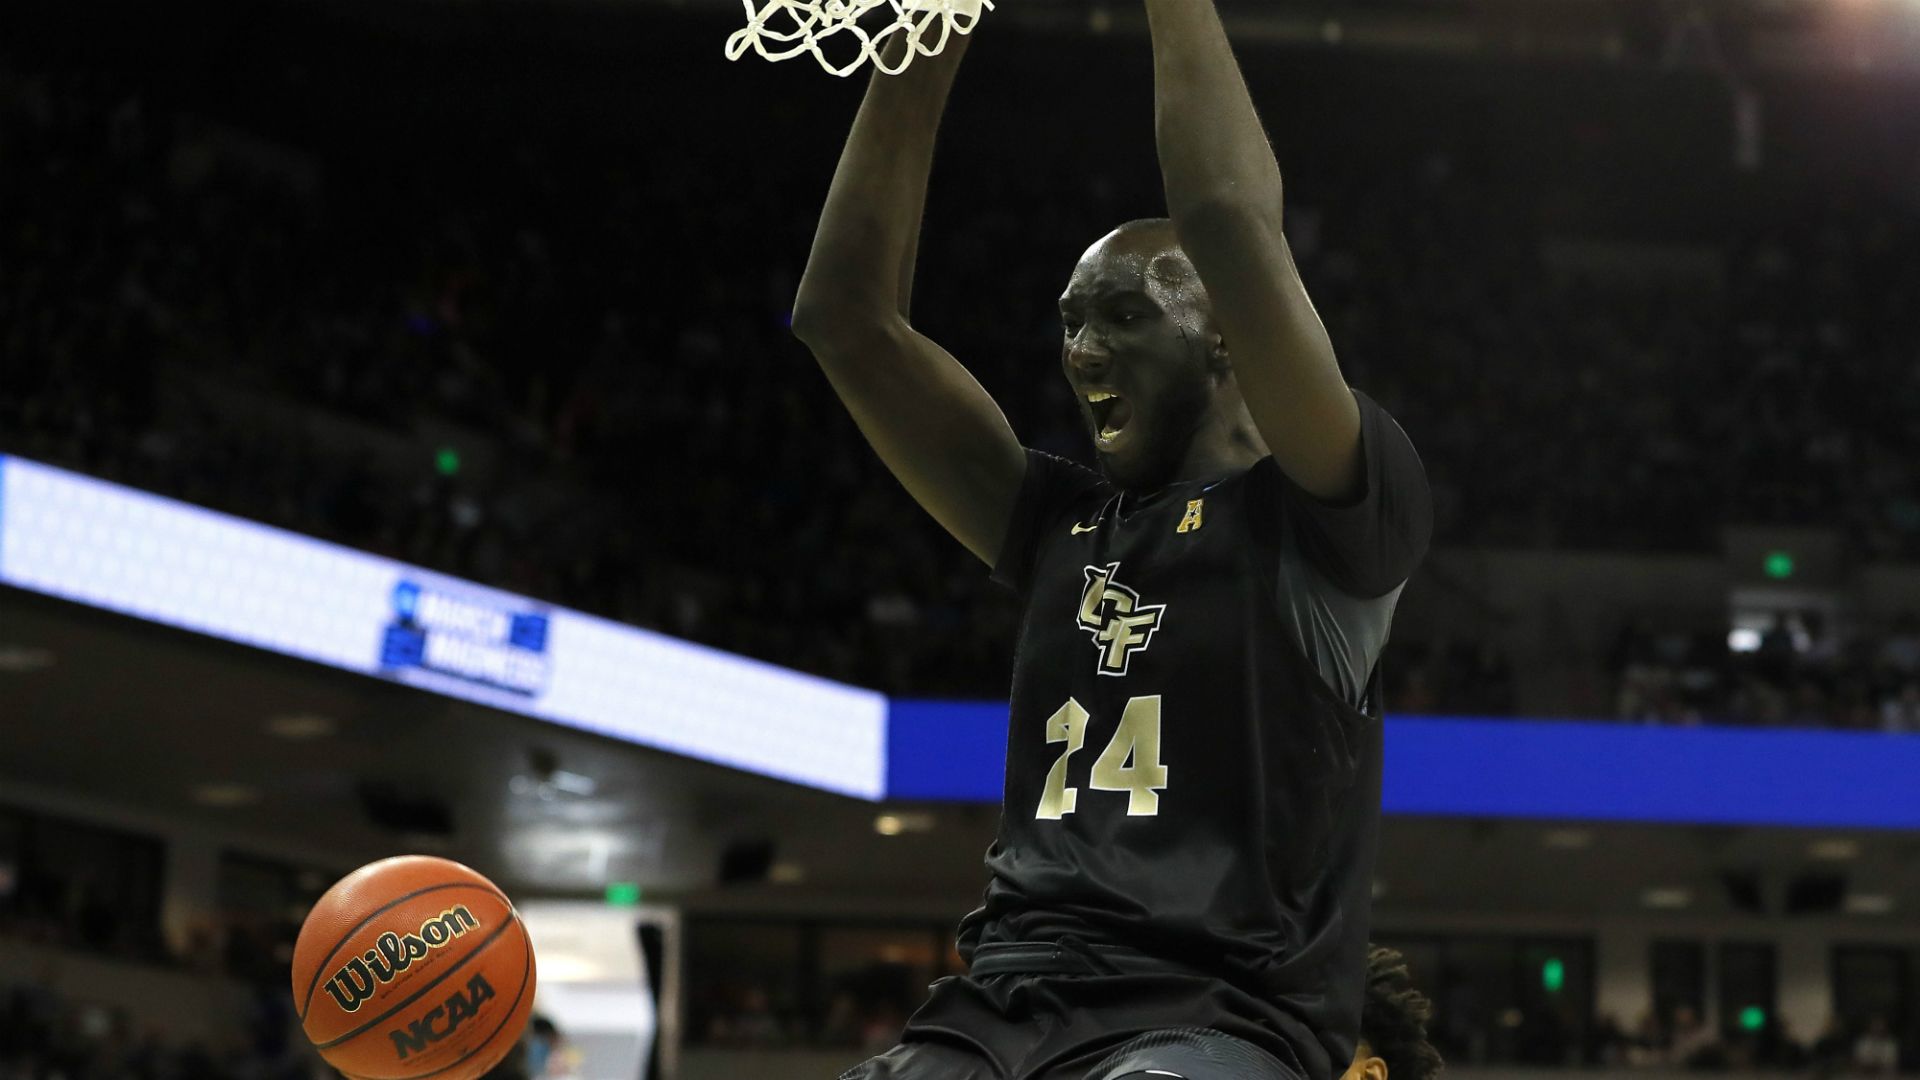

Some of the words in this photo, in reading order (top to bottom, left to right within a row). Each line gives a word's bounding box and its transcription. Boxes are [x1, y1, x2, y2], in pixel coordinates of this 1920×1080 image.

[1035, 695, 1168, 820] 24
[323, 903, 480, 1013] Wilson
[389, 972, 496, 1059] NCAA
